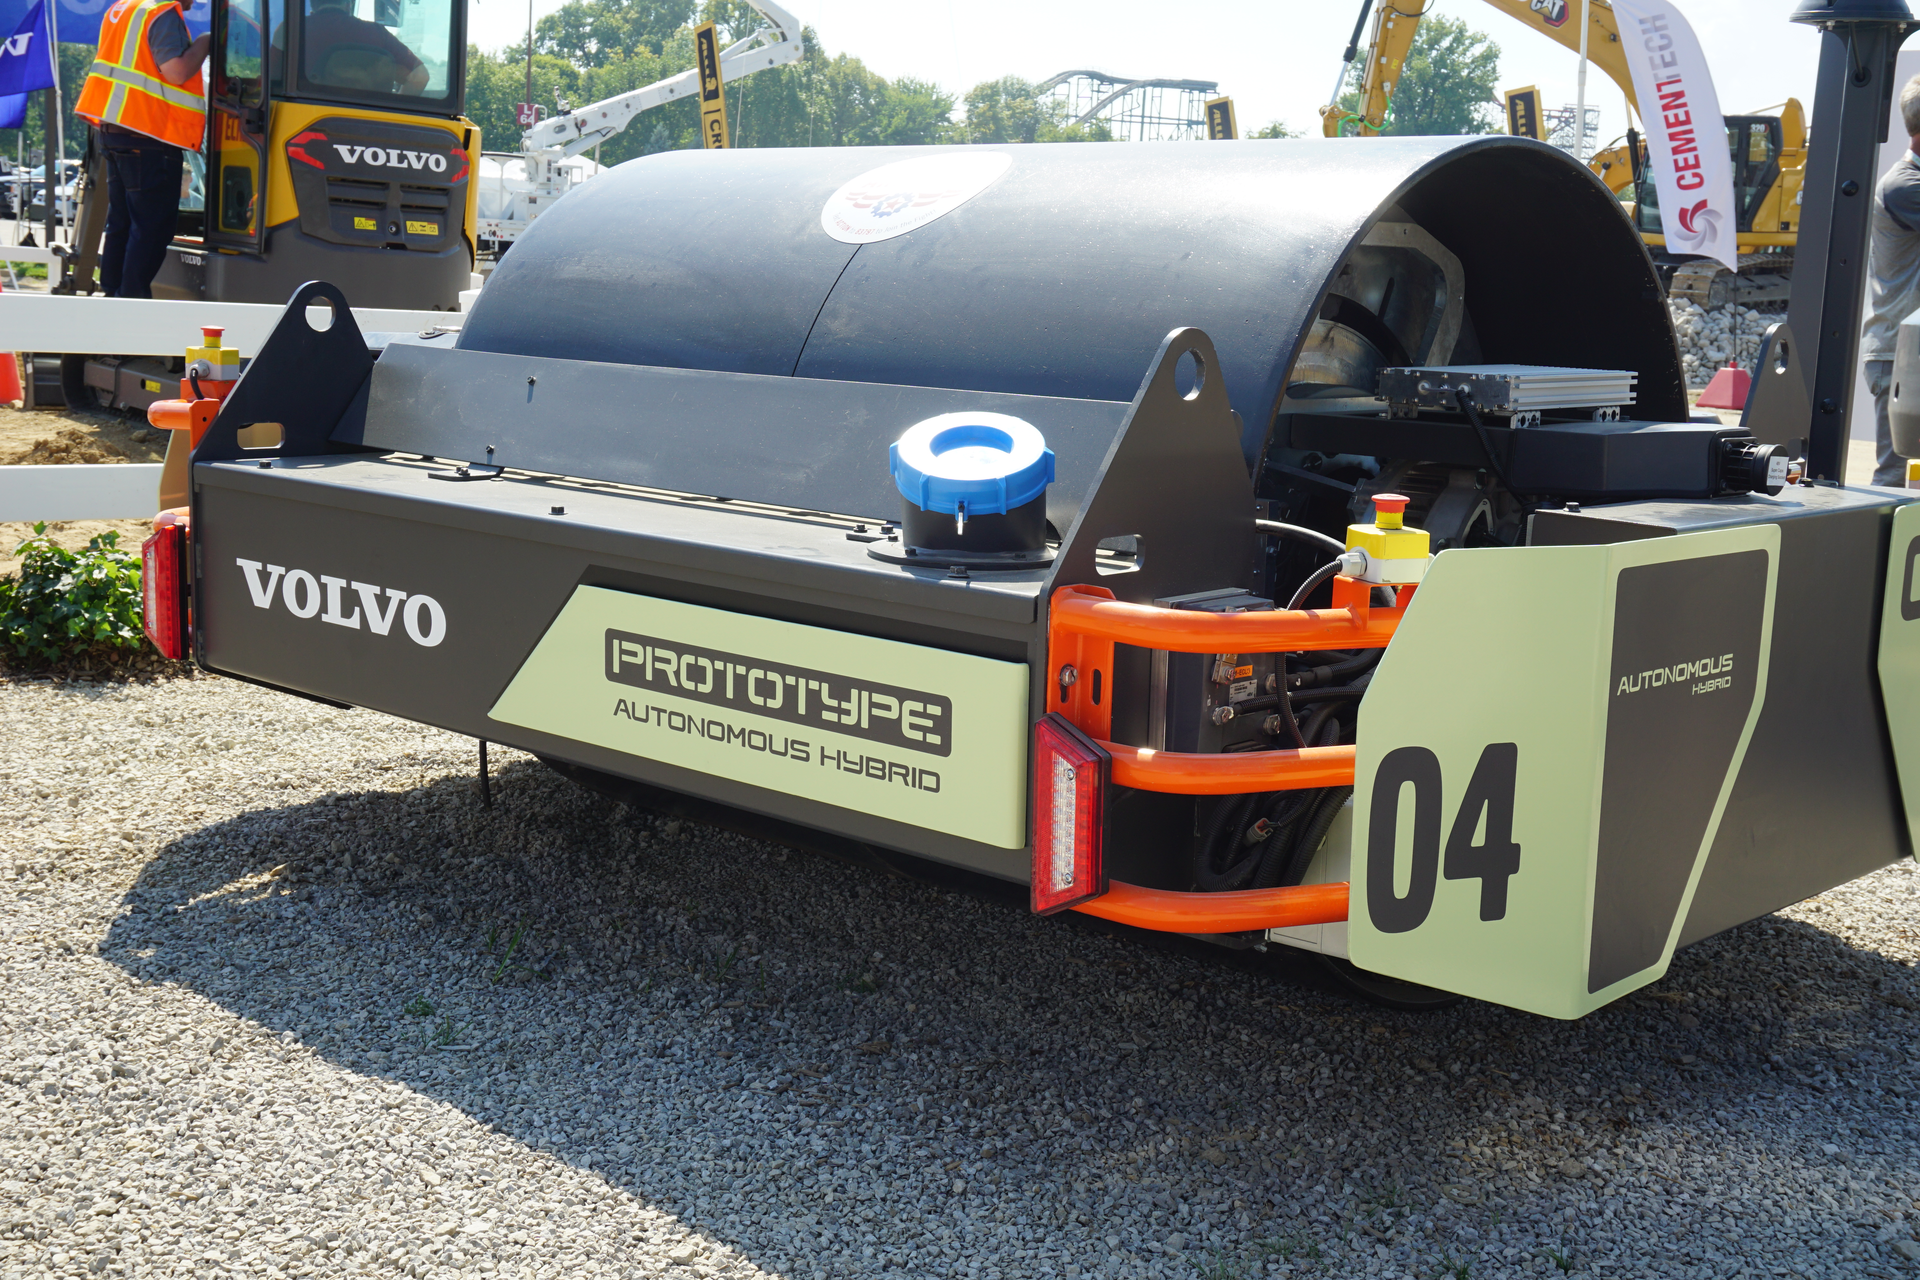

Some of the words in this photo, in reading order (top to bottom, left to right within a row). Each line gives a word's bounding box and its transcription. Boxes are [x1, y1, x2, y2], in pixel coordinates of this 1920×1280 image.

[1530, 0, 1564, 19] CAT
[523, 104, 532, 114] L
[1638, 13, 1704, 191] CEMENTECH
[333, 144, 447, 172] VOLVO
[180, 253, 202, 266] VOLVO
[236, 557, 447, 647] VOLVO
[612, 638, 943, 746] PROTOTYPE
[1617, 653, 1734, 696] AUTONOMOUS
[1692, 676, 1732, 695] HYBRID
[613, 698, 811, 763] AUTONOMOUS
[820, 745, 941, 794] HYBRID
[1366, 742, 1521, 934] 04
